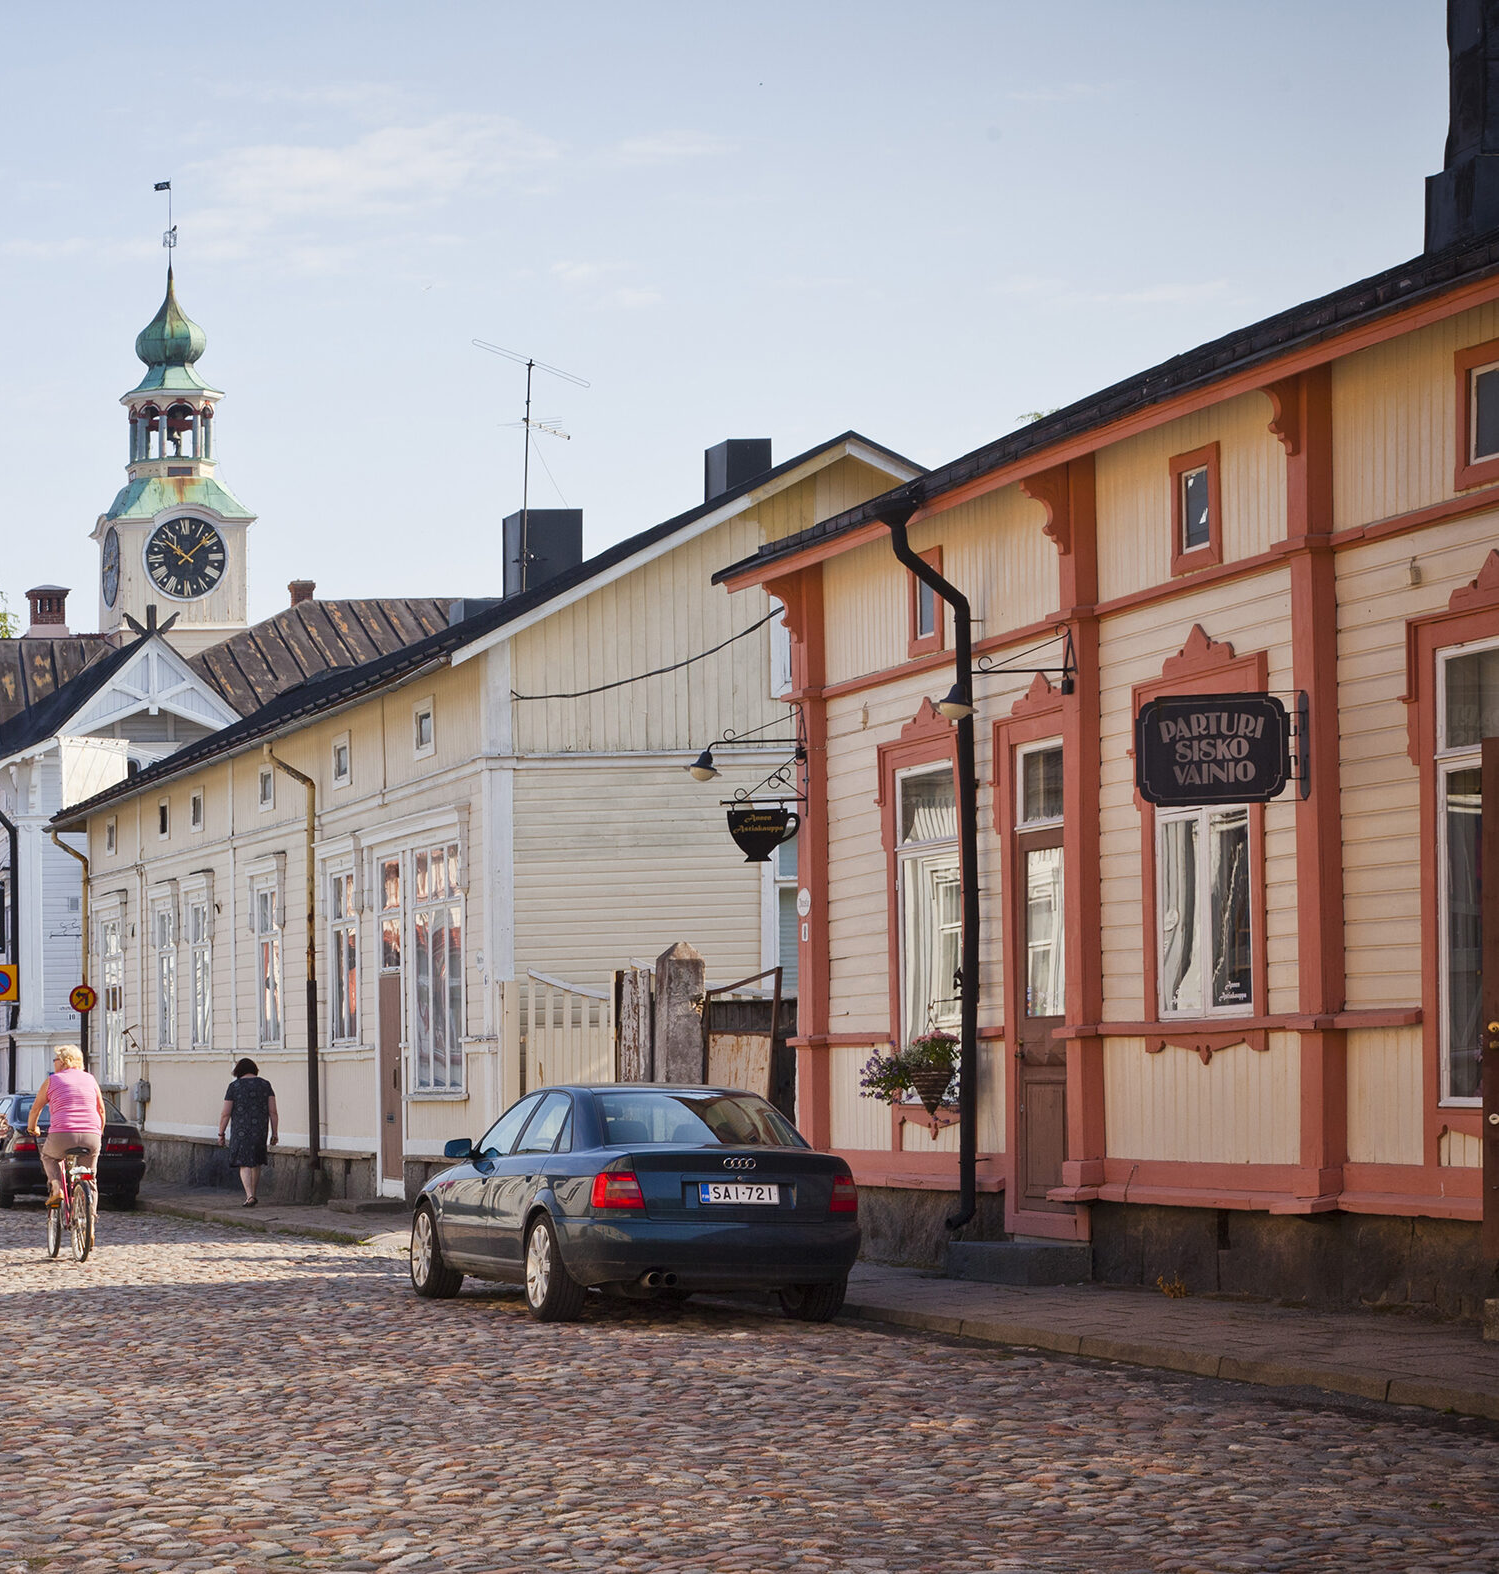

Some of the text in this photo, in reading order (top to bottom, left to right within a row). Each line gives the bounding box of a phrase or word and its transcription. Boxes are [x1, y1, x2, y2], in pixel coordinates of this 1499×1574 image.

[1158, 712, 1265, 744] PARTURI
[1175, 737, 1250, 762] SISKO
[1173, 760, 1256, 786] VAINIO
[712, 1186, 772, 1201] SAI-721
